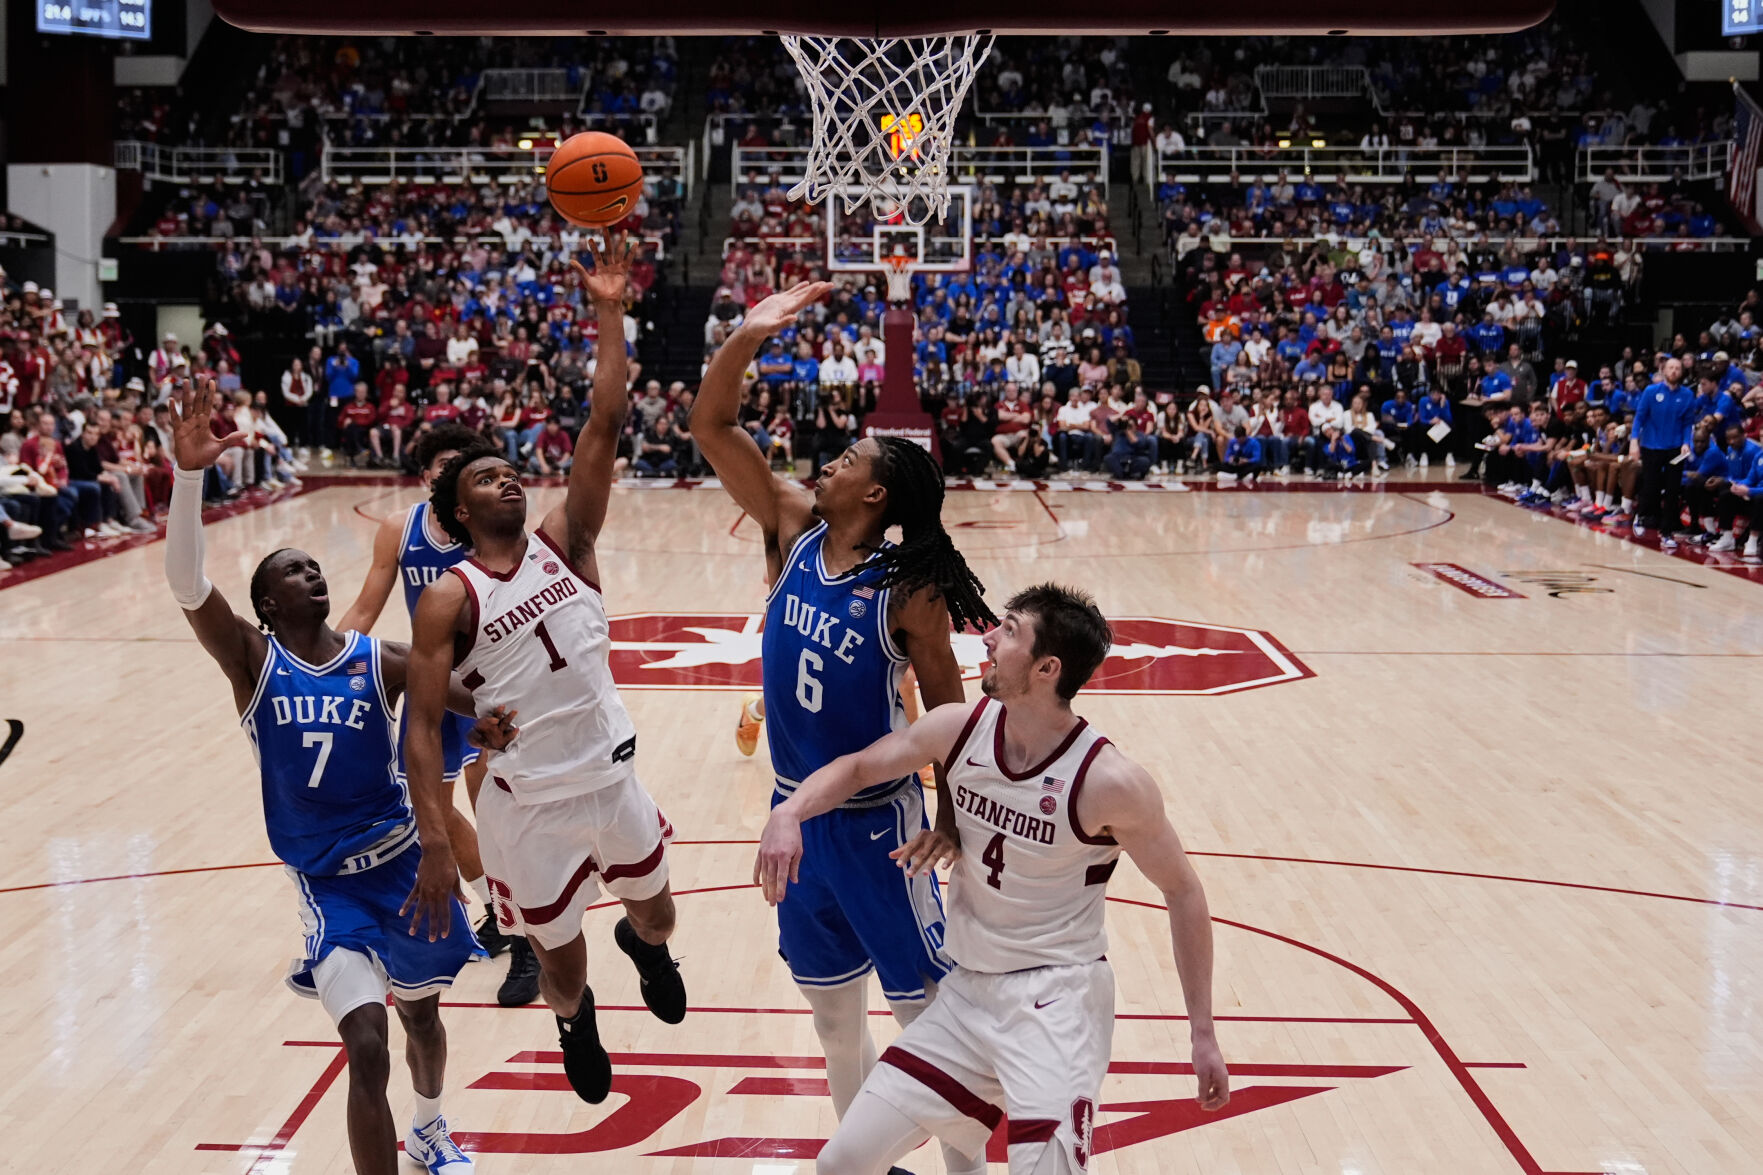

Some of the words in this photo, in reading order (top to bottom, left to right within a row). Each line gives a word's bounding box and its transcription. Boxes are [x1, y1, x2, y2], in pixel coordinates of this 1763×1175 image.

[874, 427, 904, 436] Stanford
[406, 566, 450, 586] DU
[483, 577, 578, 643] STANFORD
[784, 594, 865, 665] DUKE
[534, 620, 568, 672] 1
[796, 648, 824, 714] 6
[271, 695, 372, 730] DUKE
[302, 731, 334, 788] 7
[956, 785, 1056, 845] STANFORD
[982, 832, 1006, 890] 4
